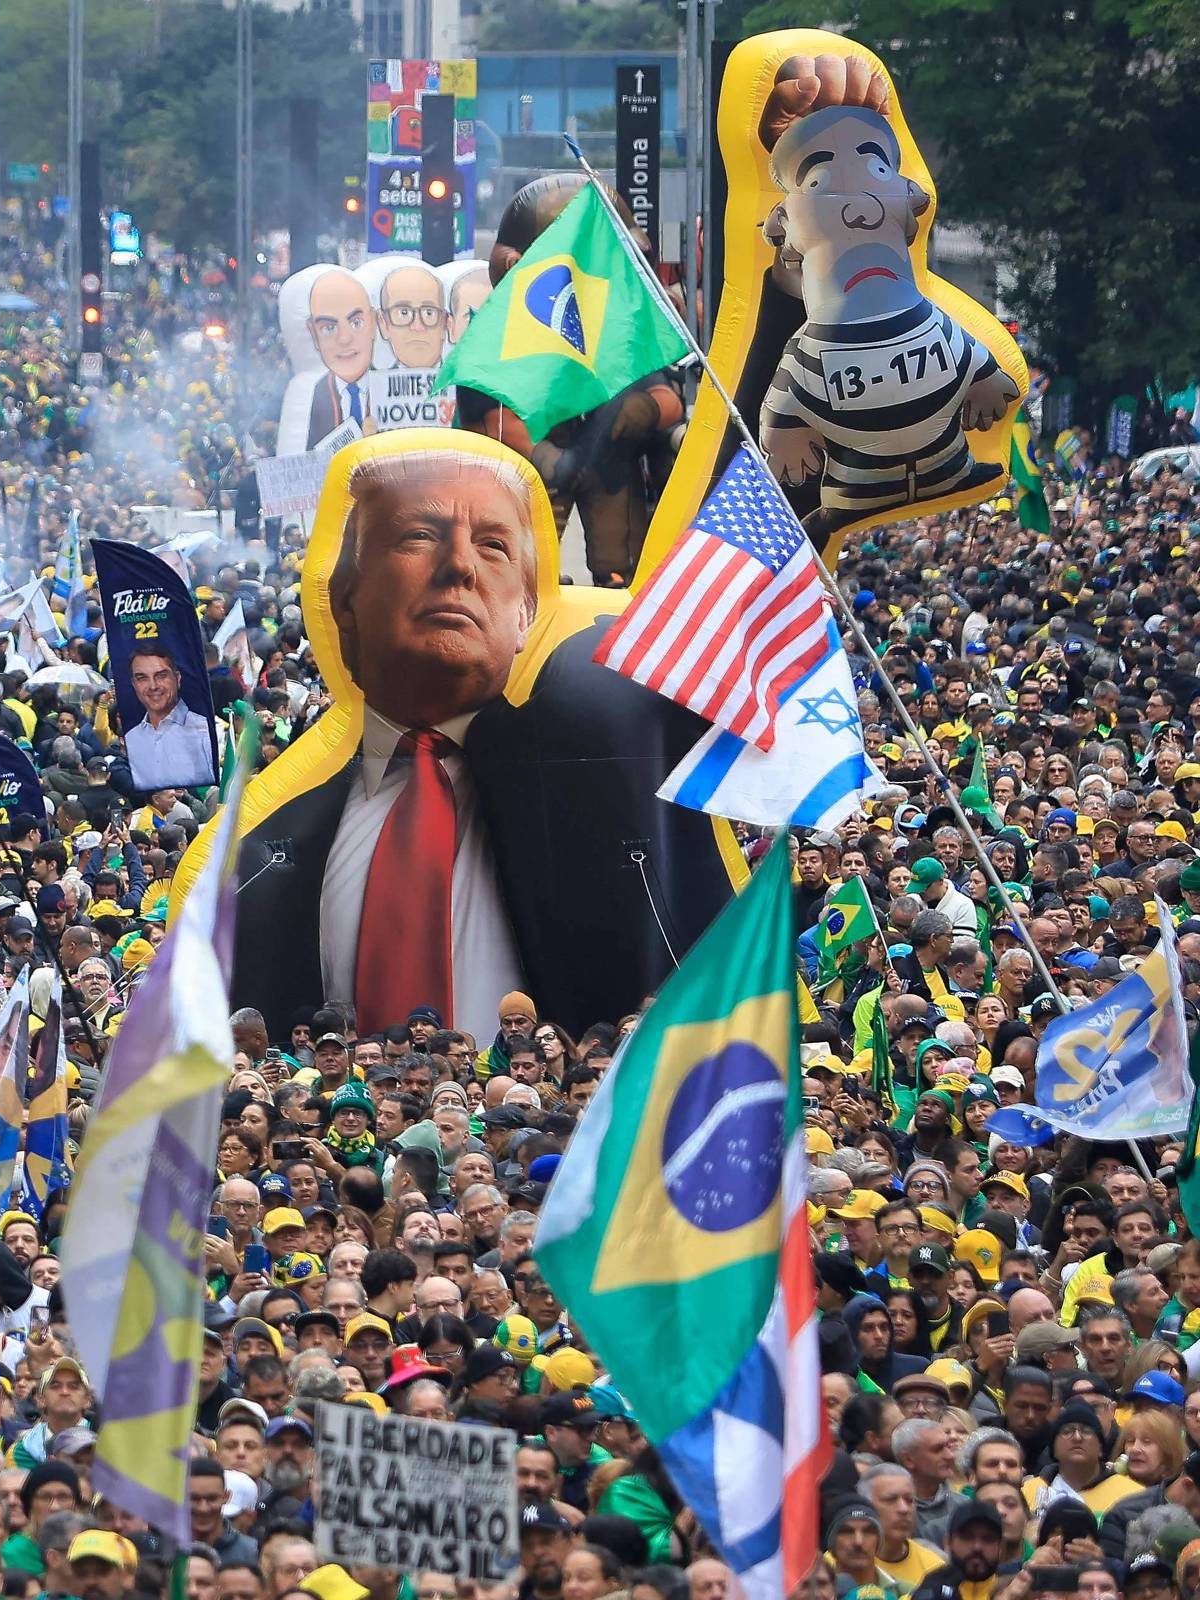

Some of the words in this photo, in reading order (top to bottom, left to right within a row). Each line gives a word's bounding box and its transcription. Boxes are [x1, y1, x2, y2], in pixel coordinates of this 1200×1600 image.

[631, 105, 647, 113] Rua
[389, 169, 401, 188] 4
[378, 402, 437, 423] NOVO
[113, 589, 170, 617] Flávio
[120, 612, 167, 623] Bolsonaro
[135, 621, 158, 639] 22
[319, 1408, 509, 1471] LIBERDADE
[320, 1450, 408, 1492] PARA
[375, 1529, 508, 1579] BRASIL
